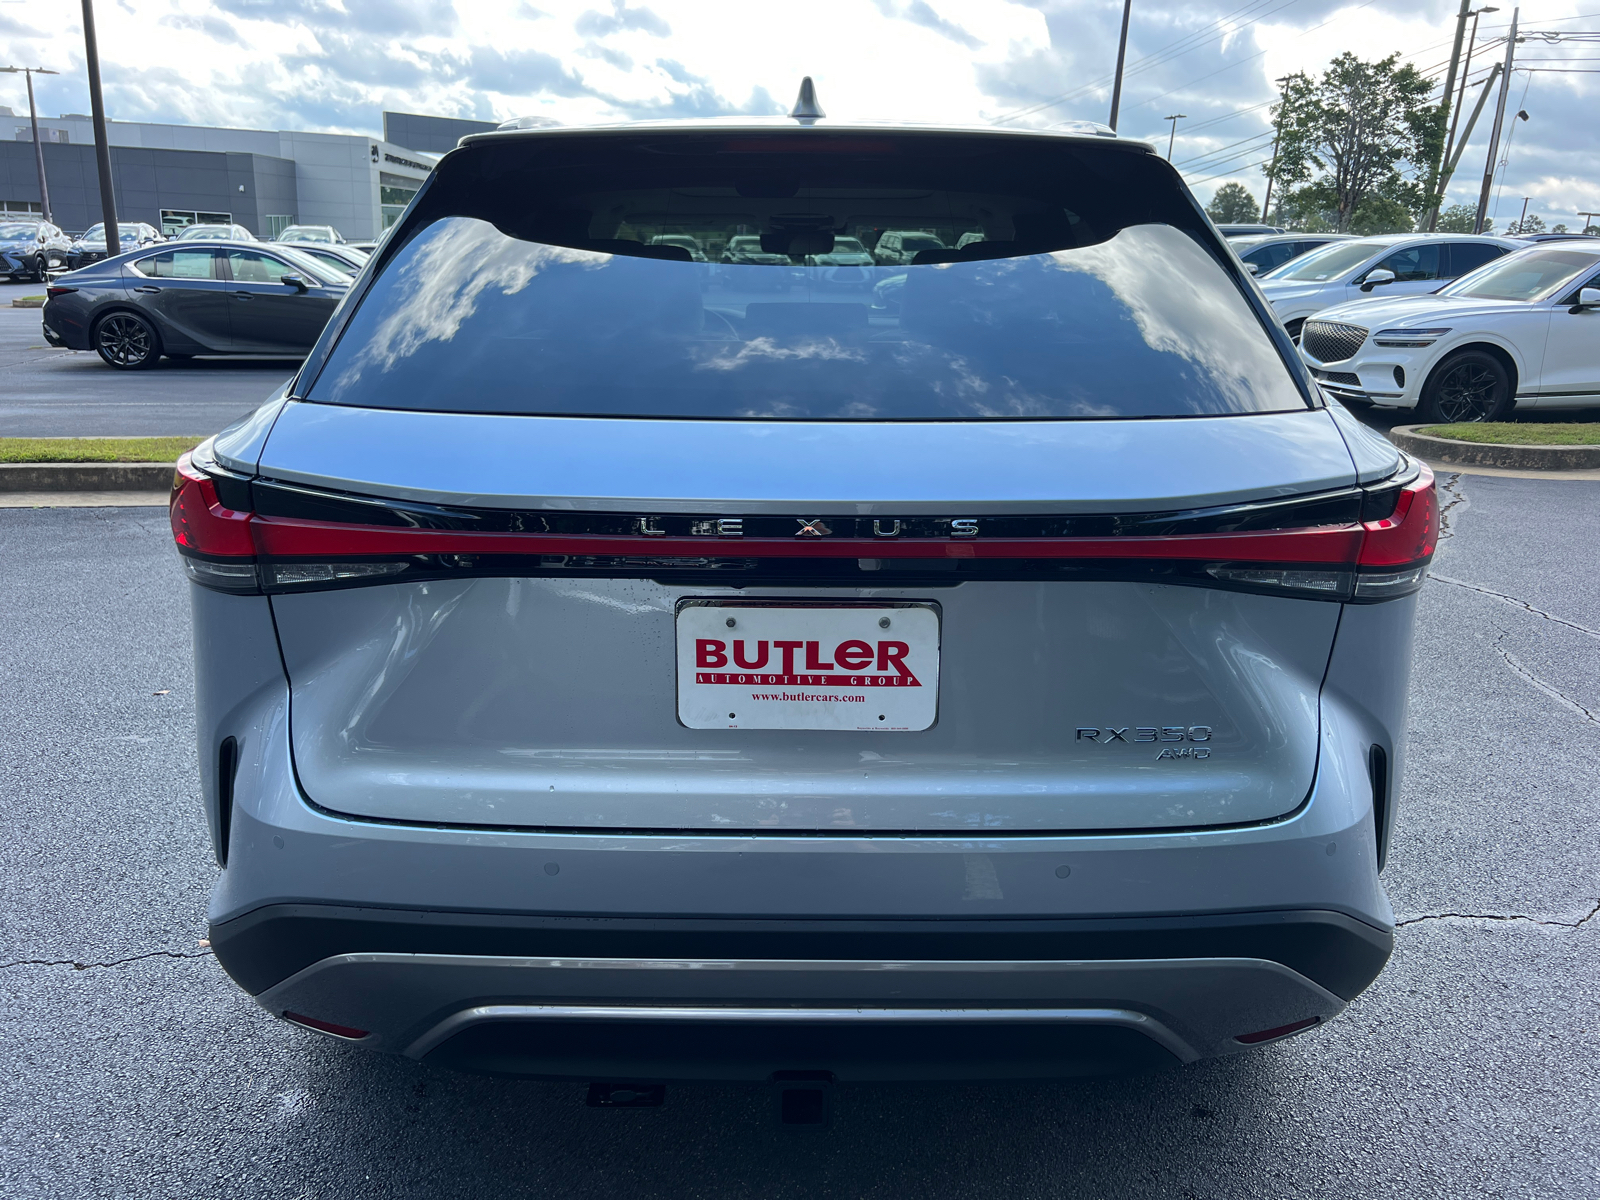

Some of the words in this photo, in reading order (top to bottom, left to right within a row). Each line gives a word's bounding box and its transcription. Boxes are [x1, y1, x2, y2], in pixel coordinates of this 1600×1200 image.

[640, 518, 979, 536] LEXUS
[697, 674, 828, 685] AUTOMOTIVE
[850, 676, 914, 686] GROUP
[751, 691, 865, 703] www.butlercars.com
[1156, 747, 1211, 760] AWD
